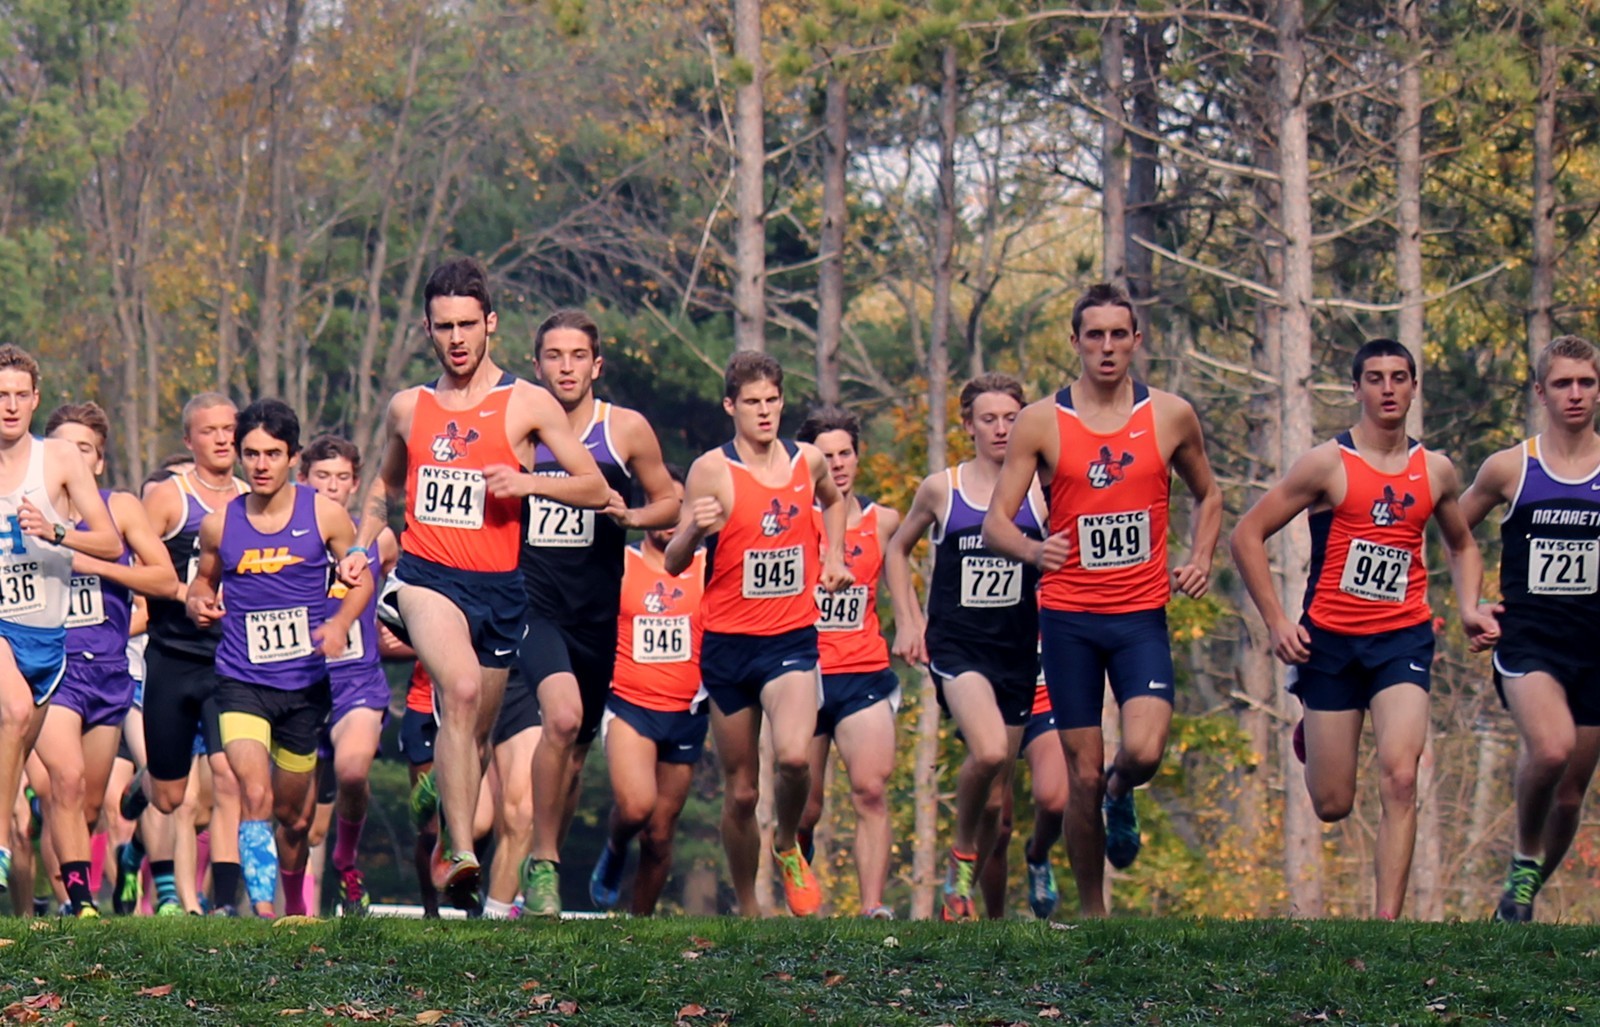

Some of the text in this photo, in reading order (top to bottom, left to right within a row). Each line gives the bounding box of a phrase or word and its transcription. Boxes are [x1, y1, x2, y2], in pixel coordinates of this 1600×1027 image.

[422, 468, 482, 482] NYSCTC
[425, 481, 472, 515] 944
[539, 507, 583, 535] 723
[1084, 512, 1144, 527] NYSCTC
[1532, 509, 1600, 526] NAZARET
[749, 547, 799, 560] NYSCTC
[1090, 526, 1140, 559] 949
[1355, 542, 1409, 562] NYSCTC
[1536, 541, 1594, 551] NYSCTC
[754, 560, 795, 588] 945
[1353, 556, 1402, 593] 942
[1540, 554, 1586, 583] 721
[972, 570, 1014, 597] 727
[251, 609, 303, 622] NYSCTC
[639, 617, 685, 627] NYSCTC
[820, 598, 859, 622] 948
[257, 622, 300, 652] 311
[643, 628, 682, 653] 946
